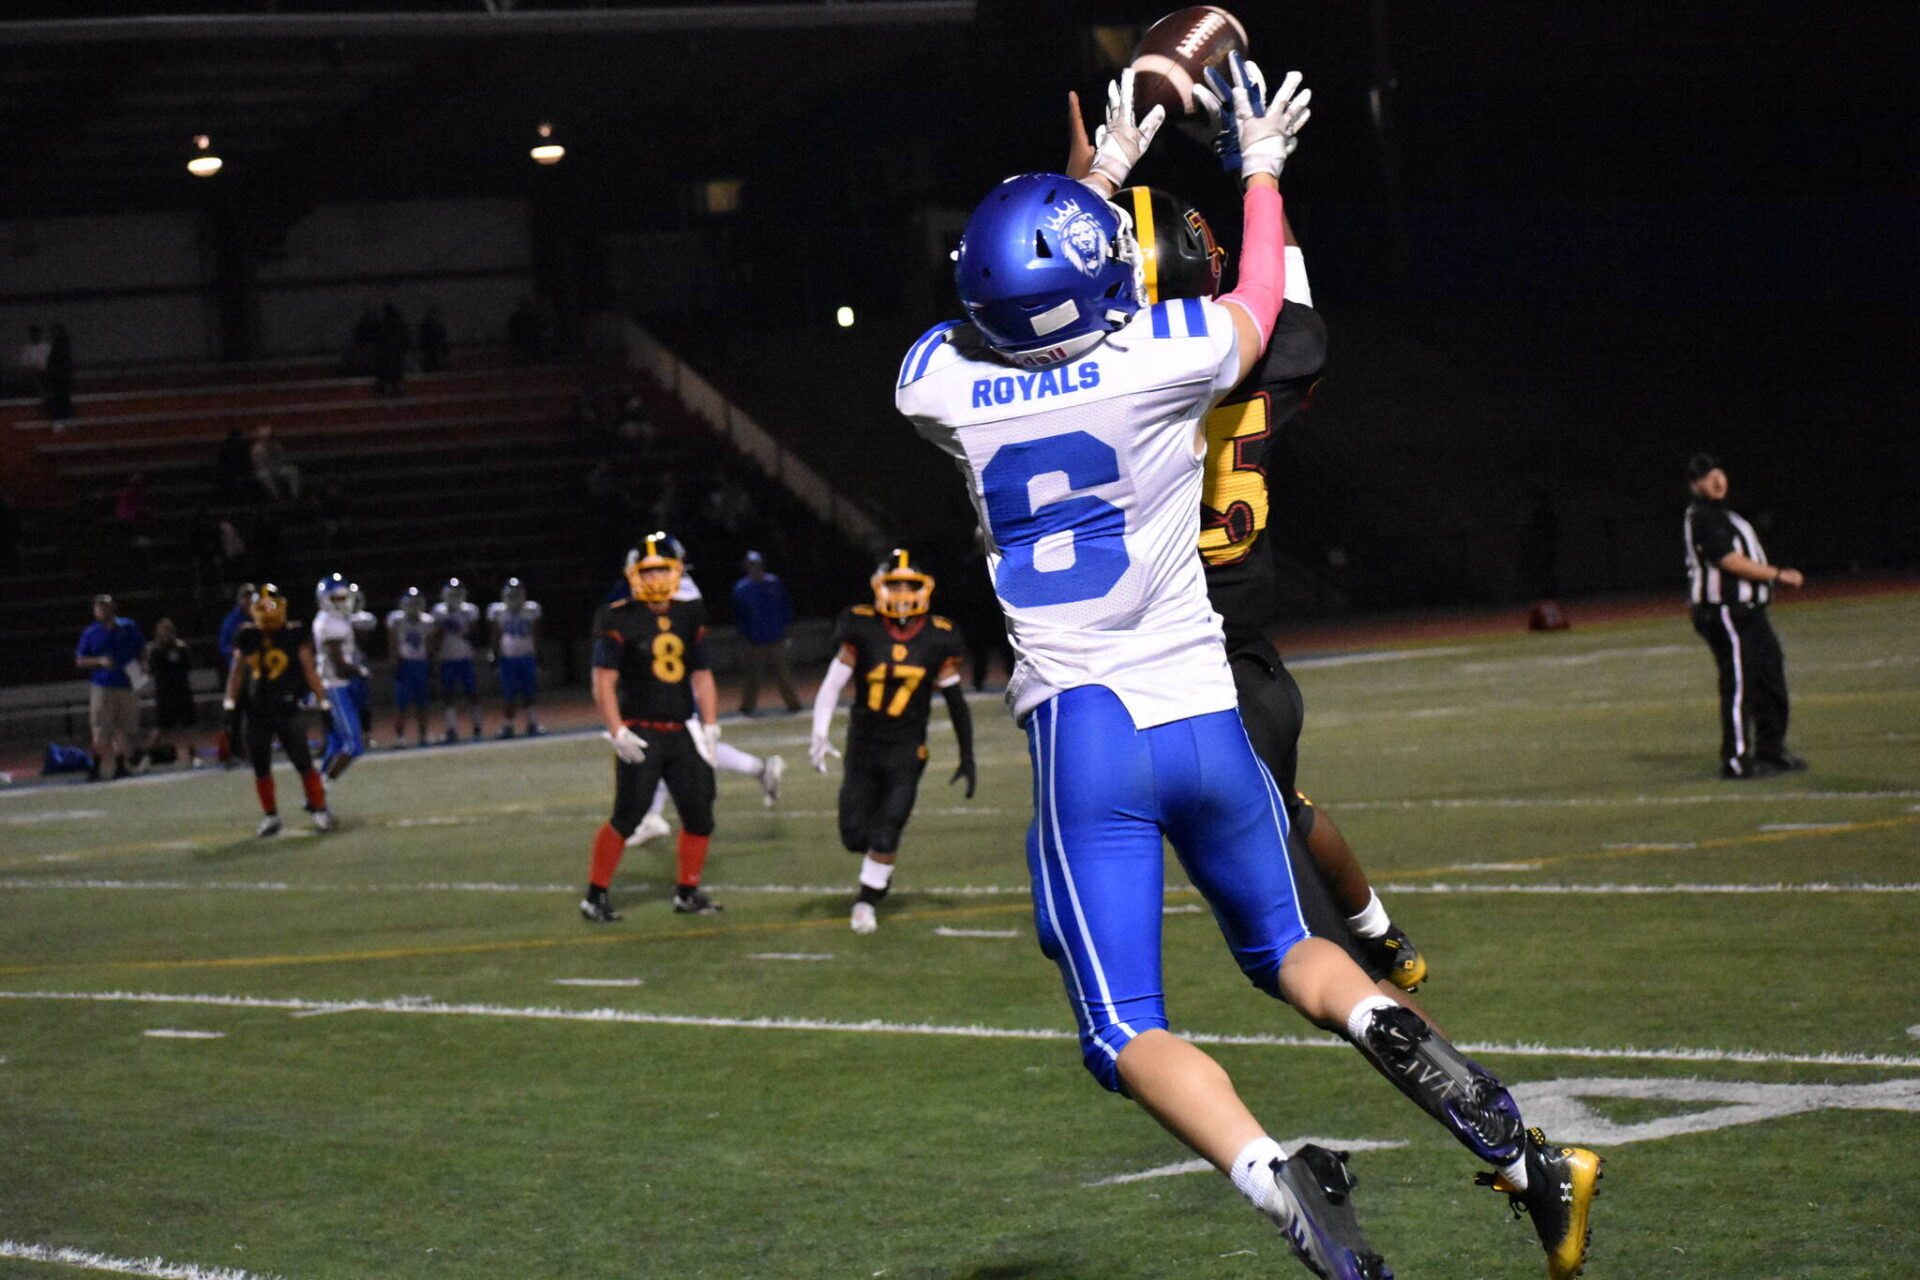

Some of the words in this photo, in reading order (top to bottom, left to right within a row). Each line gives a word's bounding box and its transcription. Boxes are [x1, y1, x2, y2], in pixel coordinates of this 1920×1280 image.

[972, 361, 1101, 408] ROYALS
[1198, 390, 1271, 566] 5
[981, 430, 1131, 609] 6
[246, 647, 290, 680] 19
[652, 632, 686, 683] 8
[866, 661, 927, 717] 17
